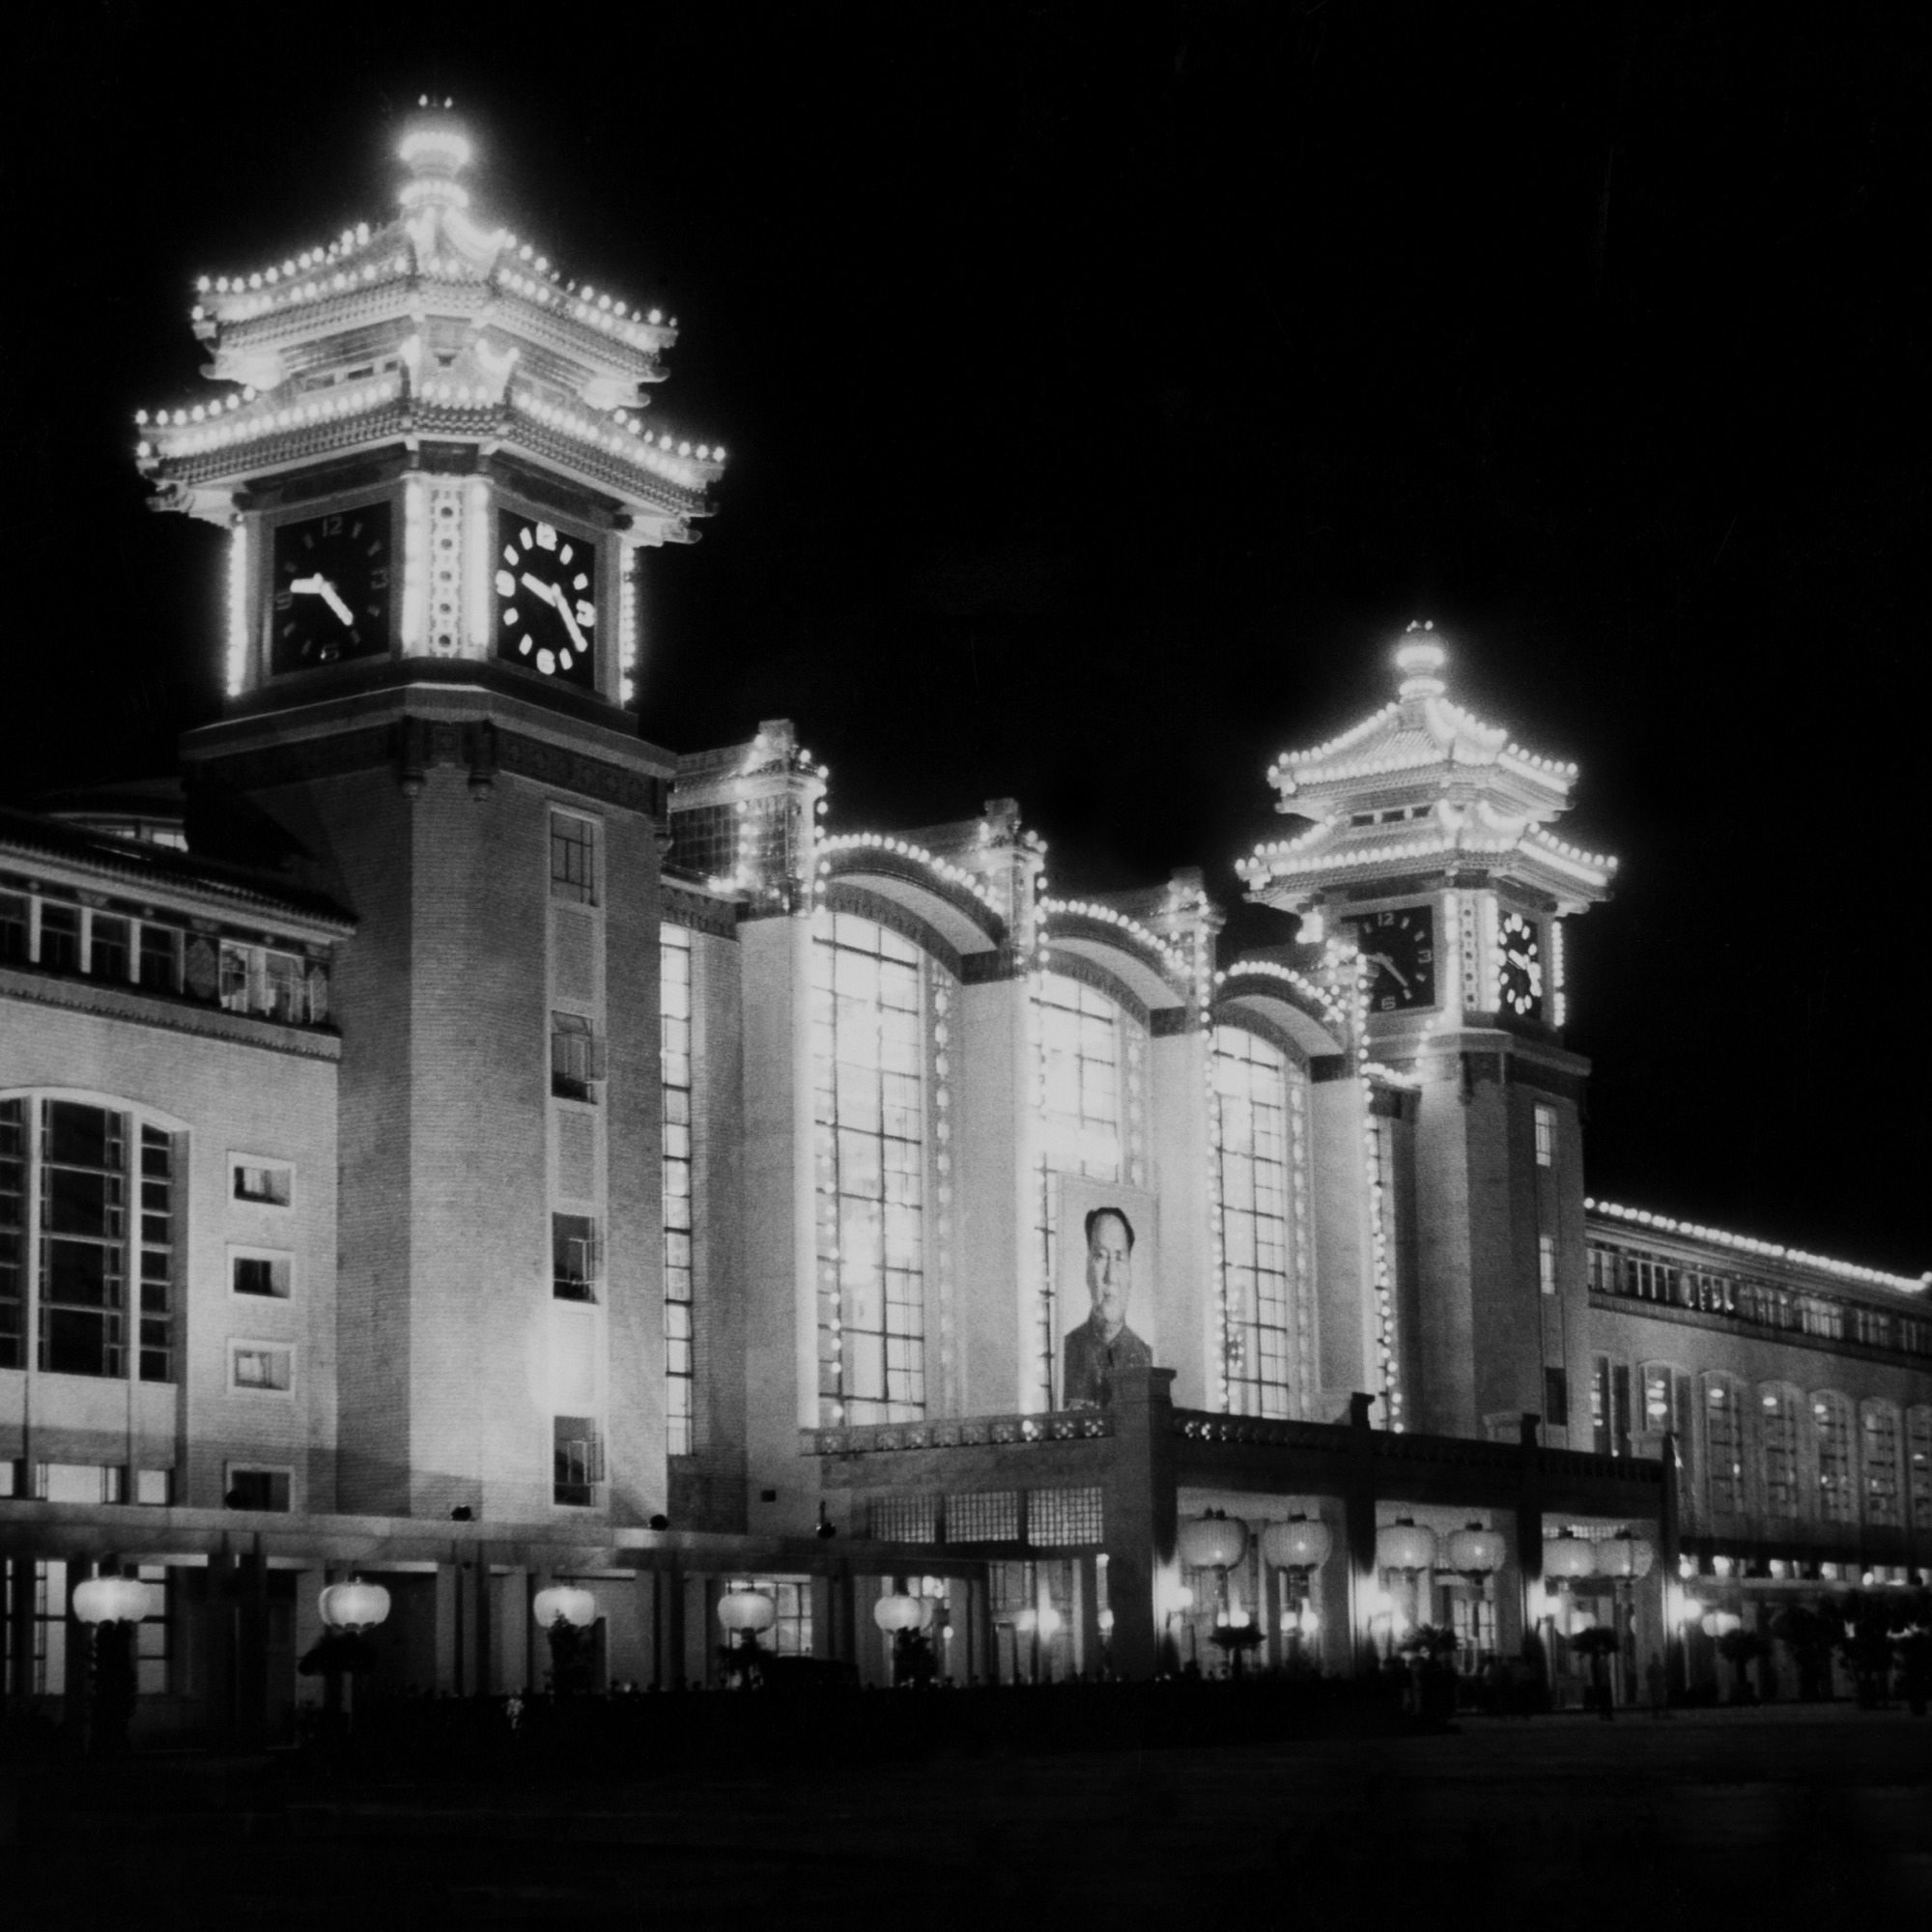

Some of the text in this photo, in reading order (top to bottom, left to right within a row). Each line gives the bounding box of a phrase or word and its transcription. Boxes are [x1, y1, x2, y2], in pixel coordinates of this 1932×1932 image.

[323, 515, 343, 537] 12
[371, 566, 389, 589] 3
[577, 599, 595, 627] 3
[1378, 912, 1394, 927] 12
[1417, 950, 1432, 964] 3
